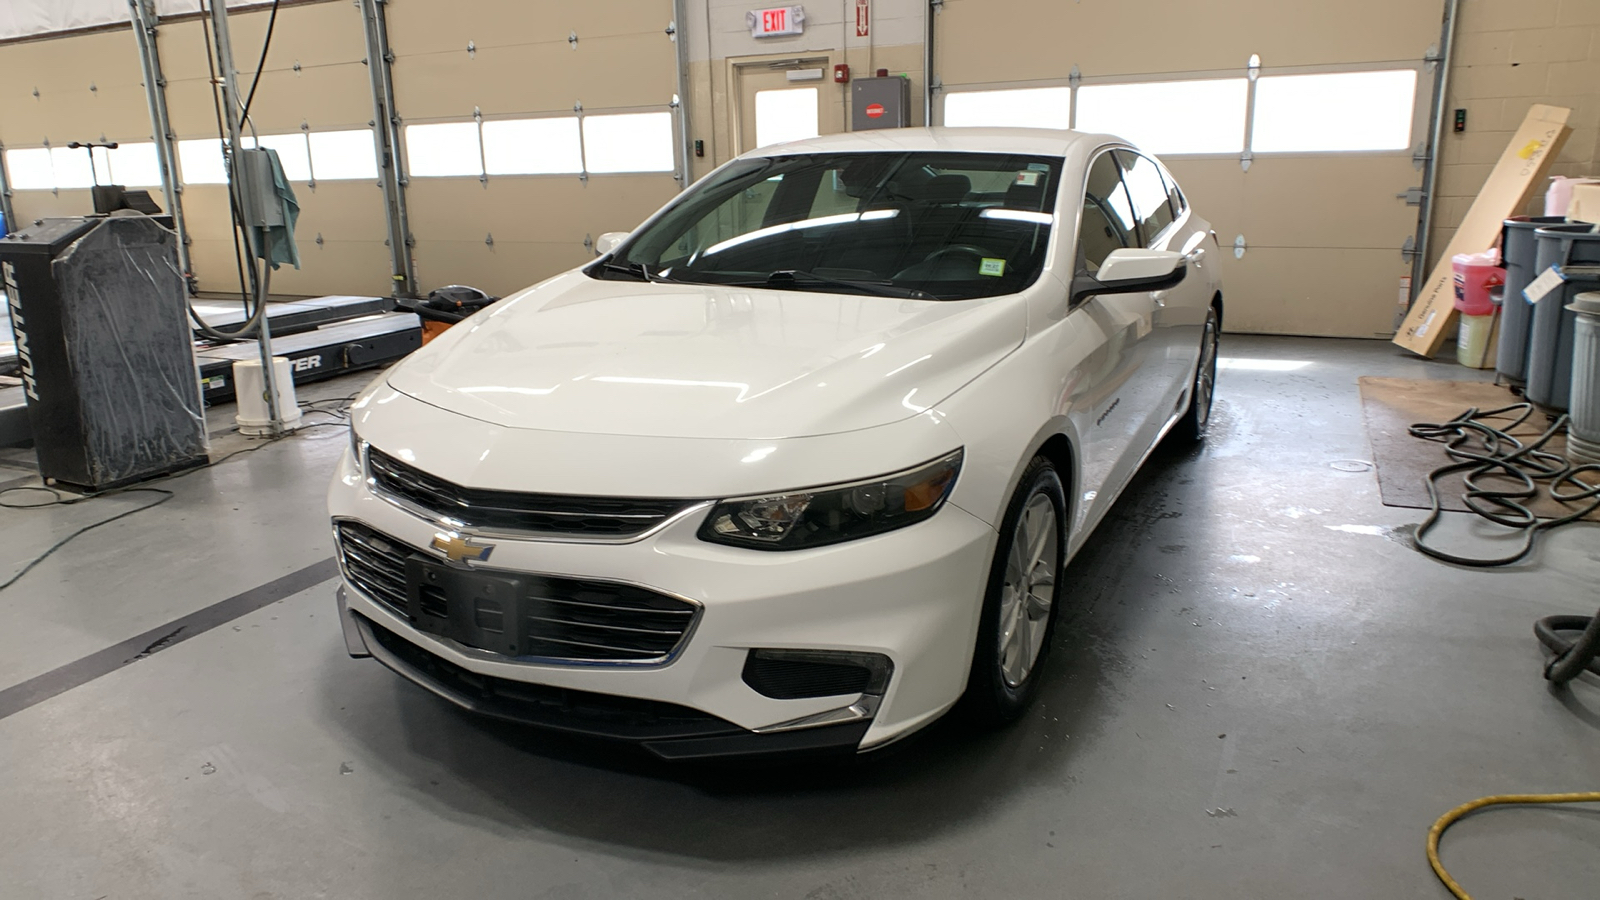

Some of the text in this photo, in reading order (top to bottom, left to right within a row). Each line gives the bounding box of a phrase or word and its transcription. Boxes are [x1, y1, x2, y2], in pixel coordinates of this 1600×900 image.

[763, 9, 786, 32] EXIT
[2, 260, 39, 401] HUNTER
[289, 355, 322, 371] TER
